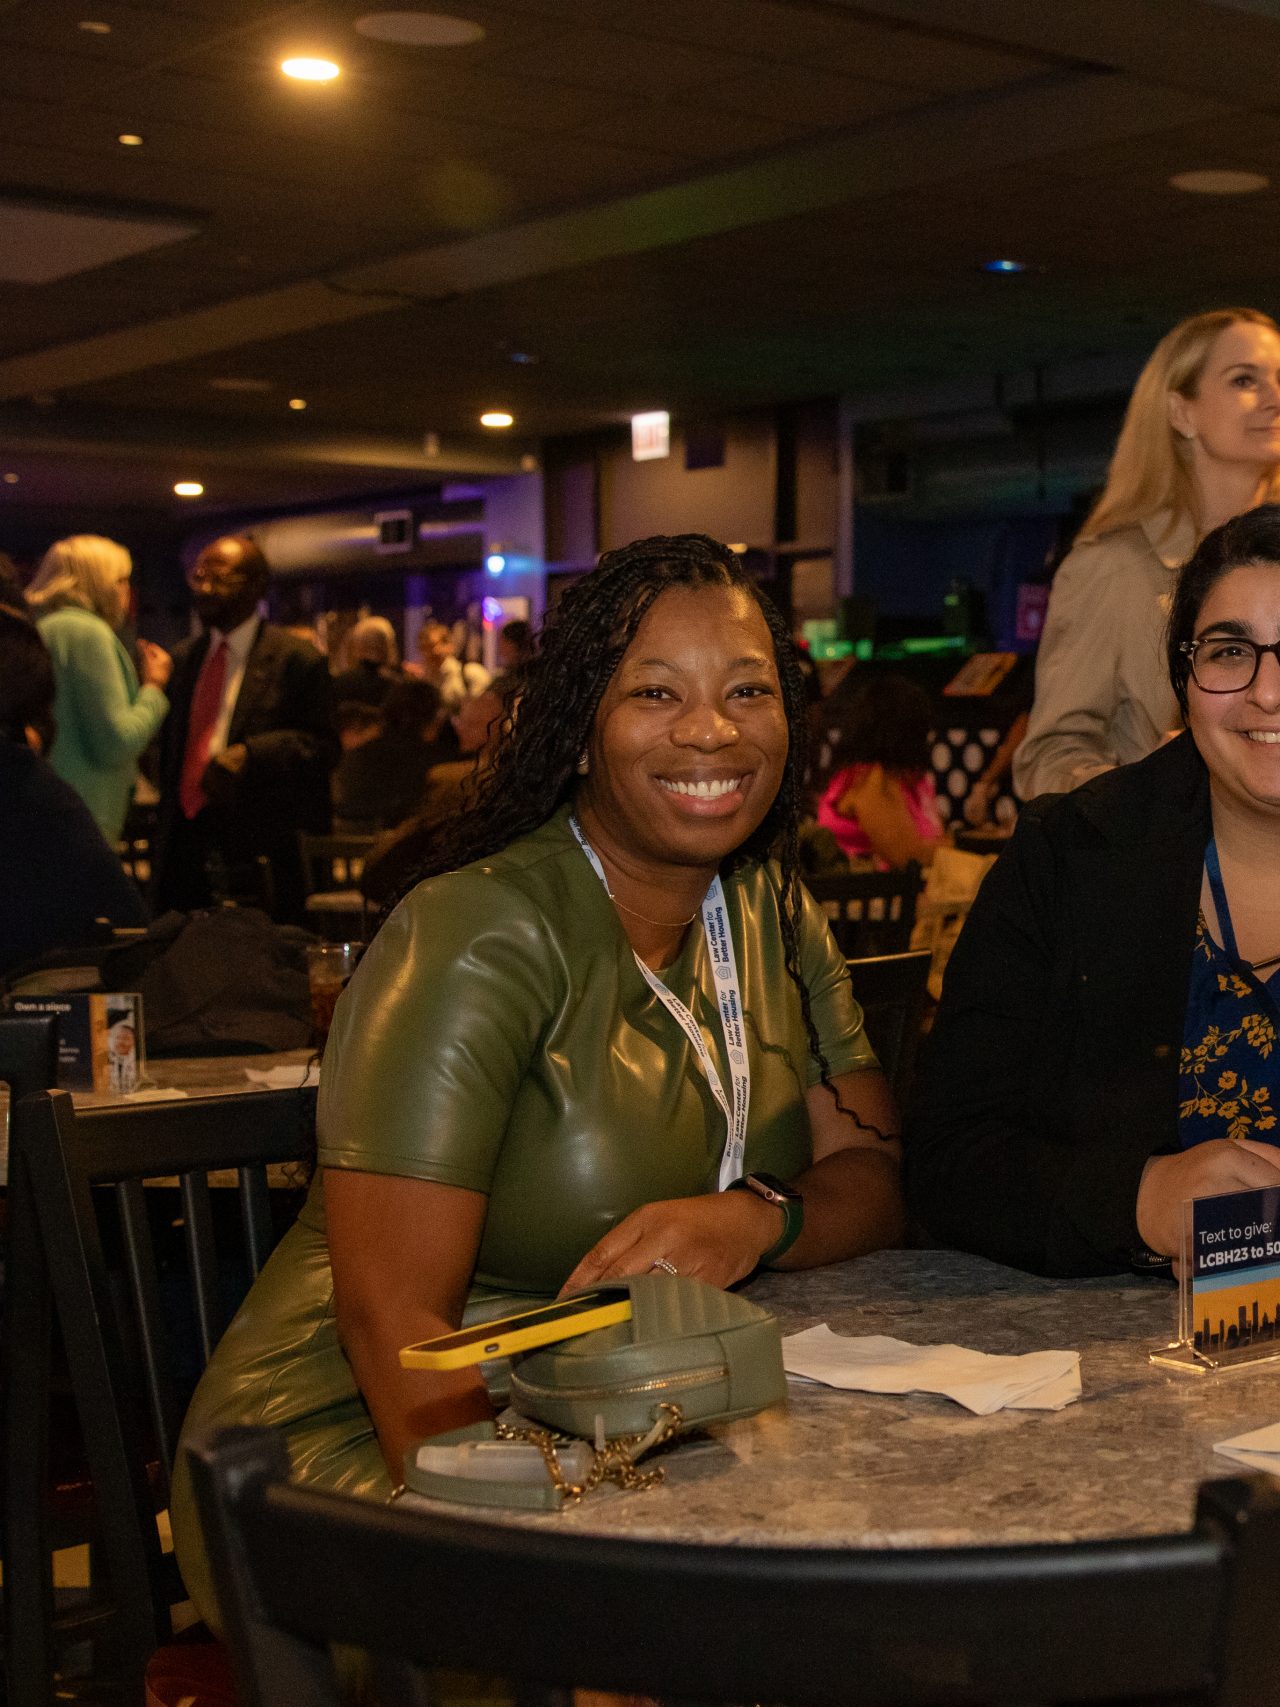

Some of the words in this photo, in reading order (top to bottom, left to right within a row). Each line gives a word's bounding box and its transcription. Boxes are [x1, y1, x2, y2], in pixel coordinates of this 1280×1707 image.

[706, 911, 714, 921] for
[715, 906, 726, 938] Housing
[708, 922, 718, 947] Center
[713, 949, 721, 963] Law
[720, 940, 730, 963] Better
[722, 1002, 732, 1028] Center
[728, 989, 738, 1022] Housing
[666, 998, 687, 1021] Better
[685, 1022, 705, 1058] Housing
[673, 997, 687, 1013] Law
[686, 1014, 703, 1042] Center
[726, 1029, 735, 1046] Law
[733, 1023, 743, 1048] Better
[1199, 1230, 1227, 1244] Text
[1229, 1227, 1242, 1239] to
[1244, 1221, 1273, 1240] give:
[1199, 1248, 1249, 1269] LCBH23
[1251, 1246, 1264, 1259] to
